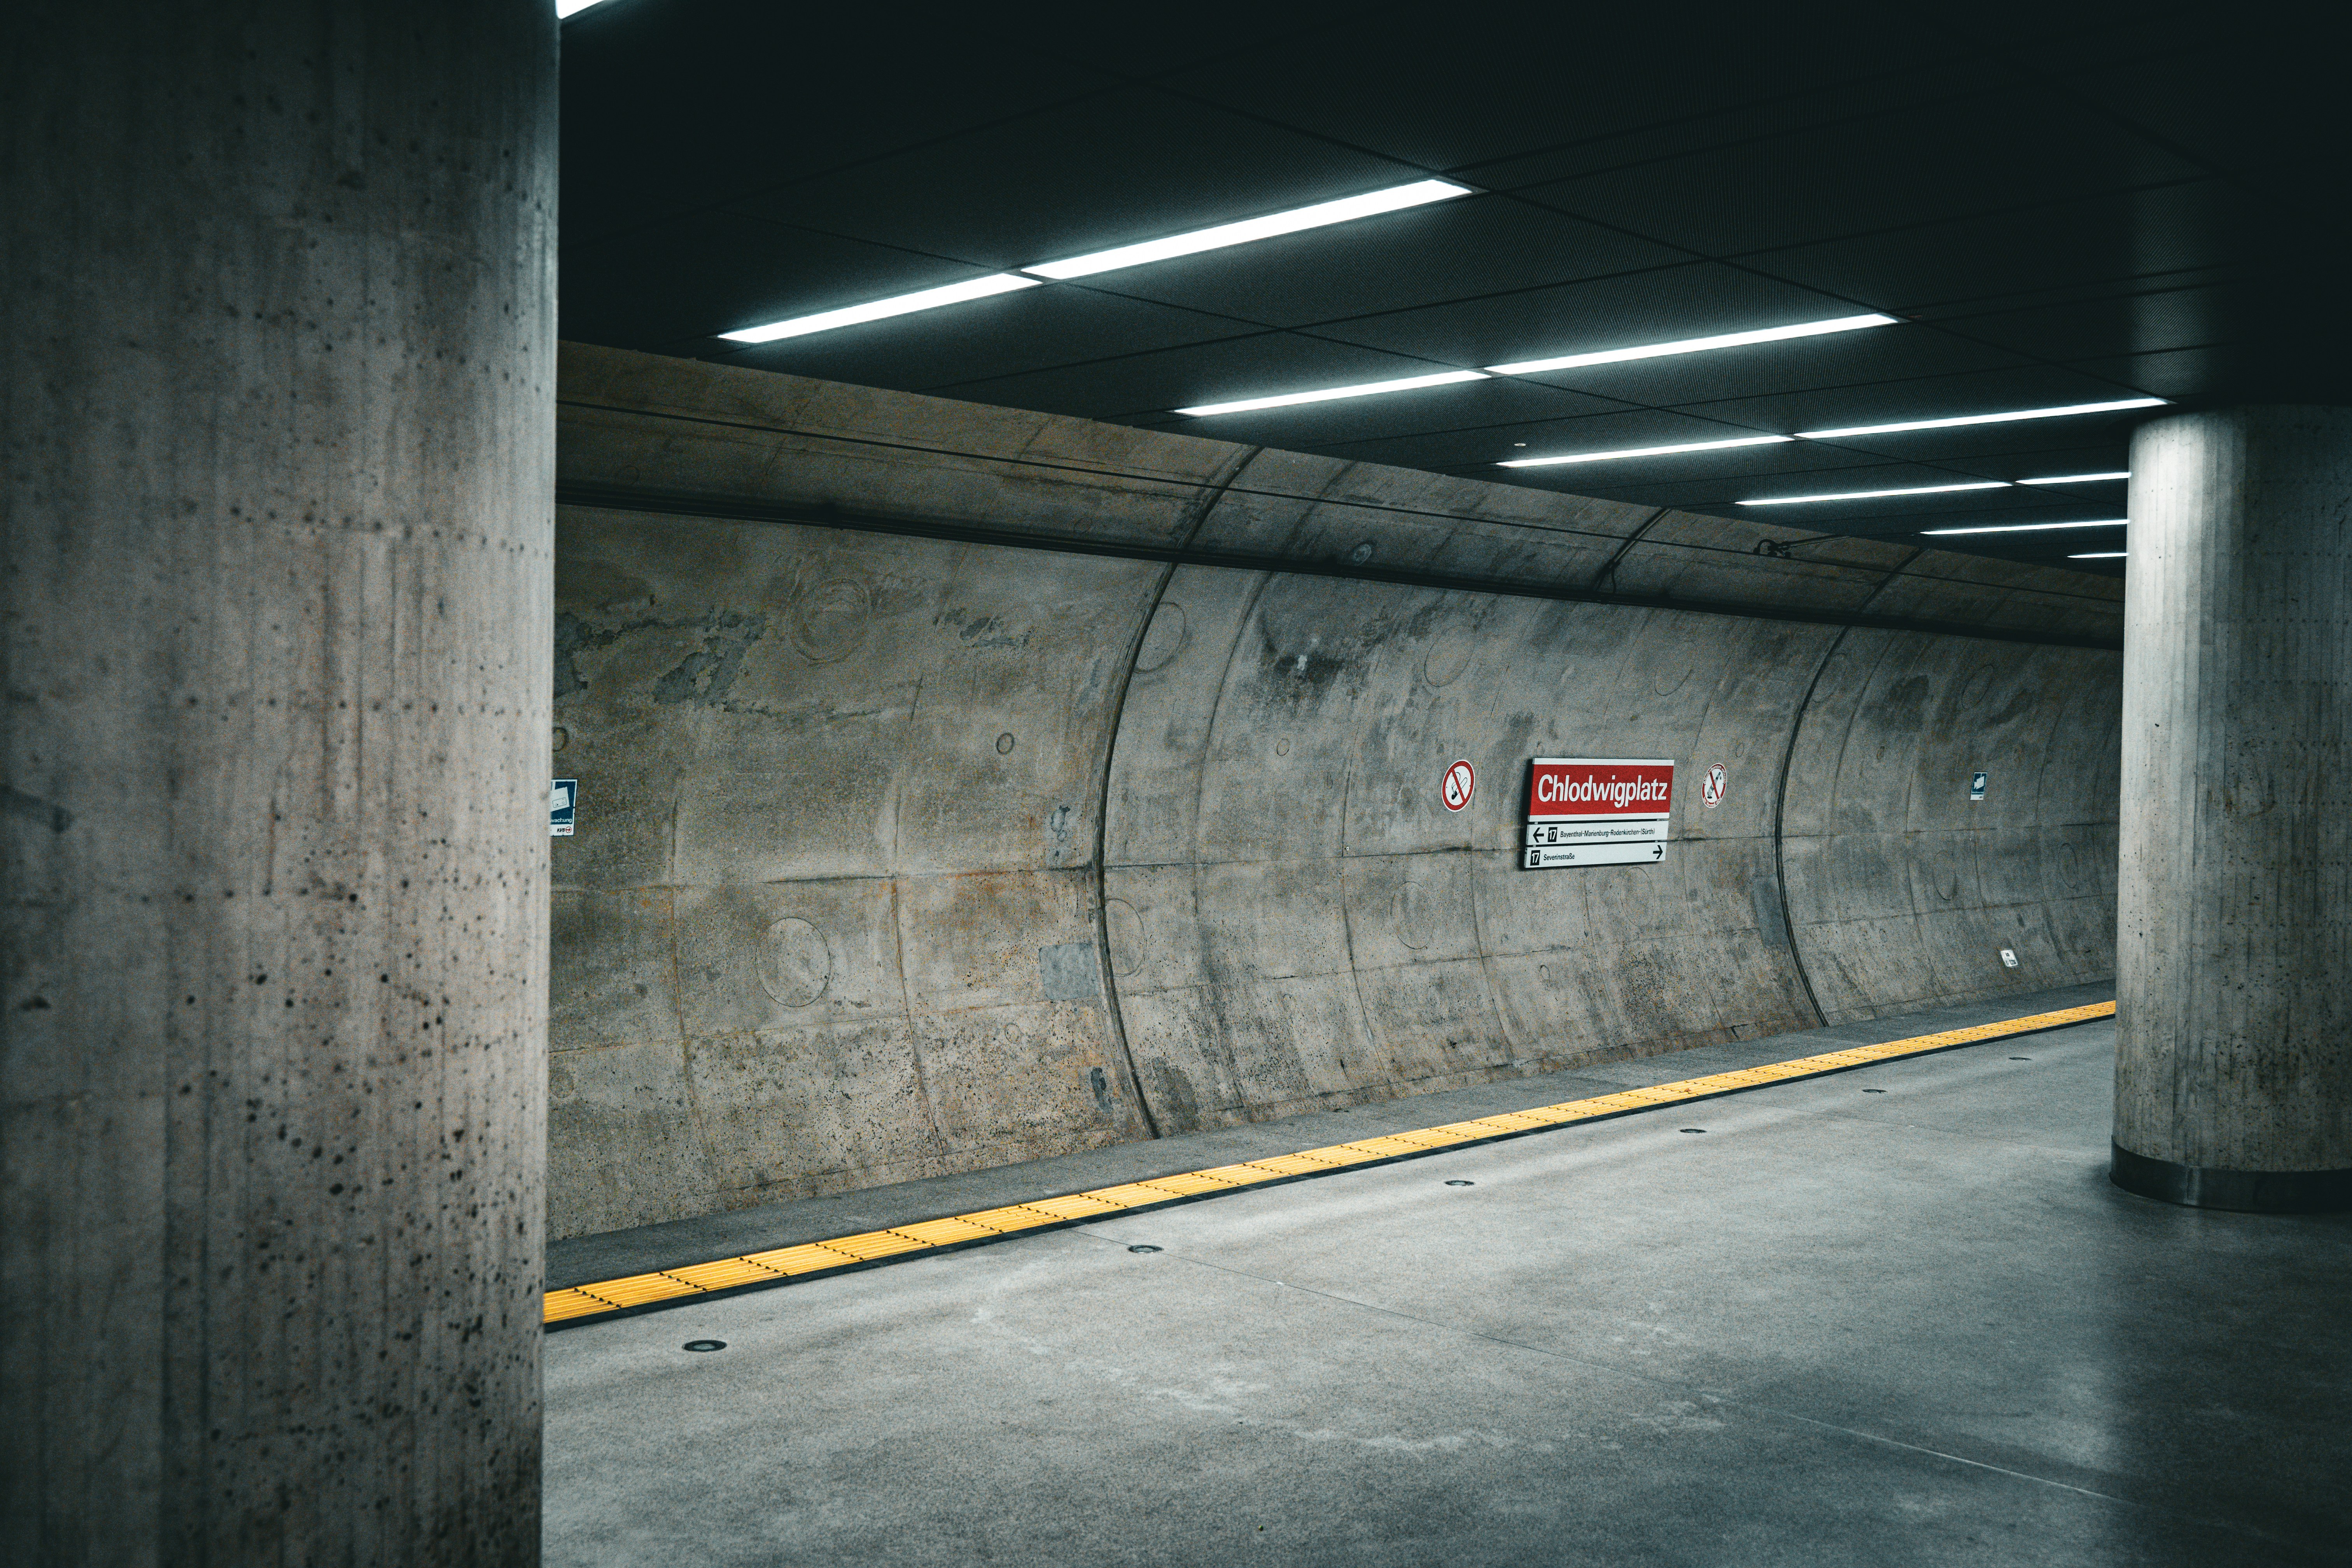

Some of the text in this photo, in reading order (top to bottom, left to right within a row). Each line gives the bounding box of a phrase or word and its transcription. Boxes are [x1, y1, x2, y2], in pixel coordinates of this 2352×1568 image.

[1538, 774, 1668, 808] Chlodwigplatz
[1549, 828, 1655, 840] 17 Bayenthal-Marienburg-Rodenkirchen-(Sürth)
[1531, 852, 1540, 863] 17
